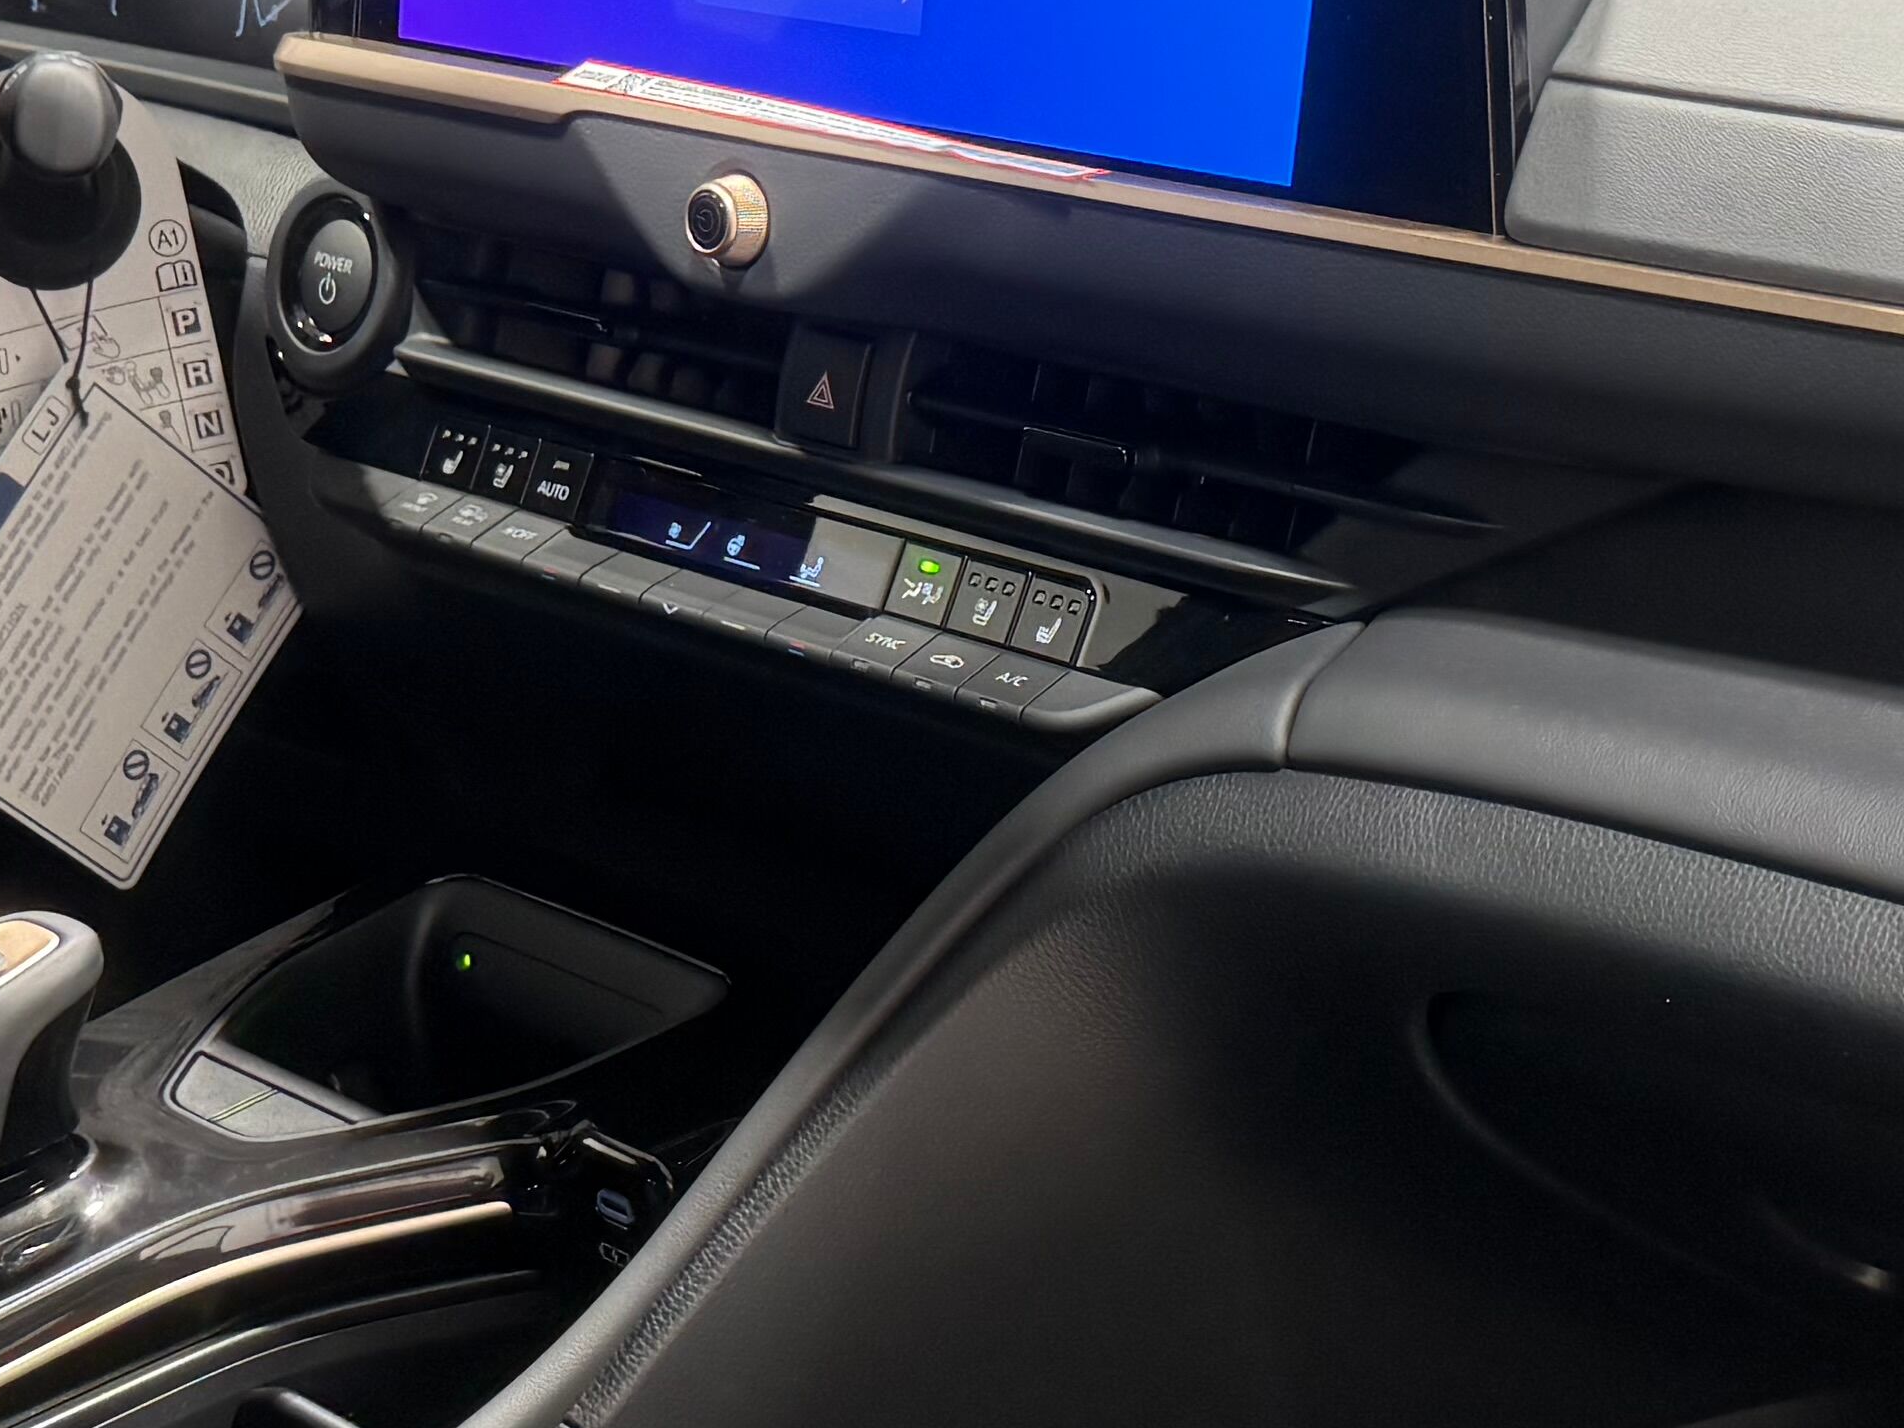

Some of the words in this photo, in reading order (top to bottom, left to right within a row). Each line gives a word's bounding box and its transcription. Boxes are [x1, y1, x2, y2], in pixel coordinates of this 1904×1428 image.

[157, 228, 179, 250] A1
[314, 251, 353, 274] POWER
[175, 310, 197, 334] P
[185, 361, 209, 386] R
[197, 412, 221, 437] N
[537, 480, 570, 502] AUTO
[865, 632, 906, 650] SYNC
[996, 672, 1029, 687] A/C
